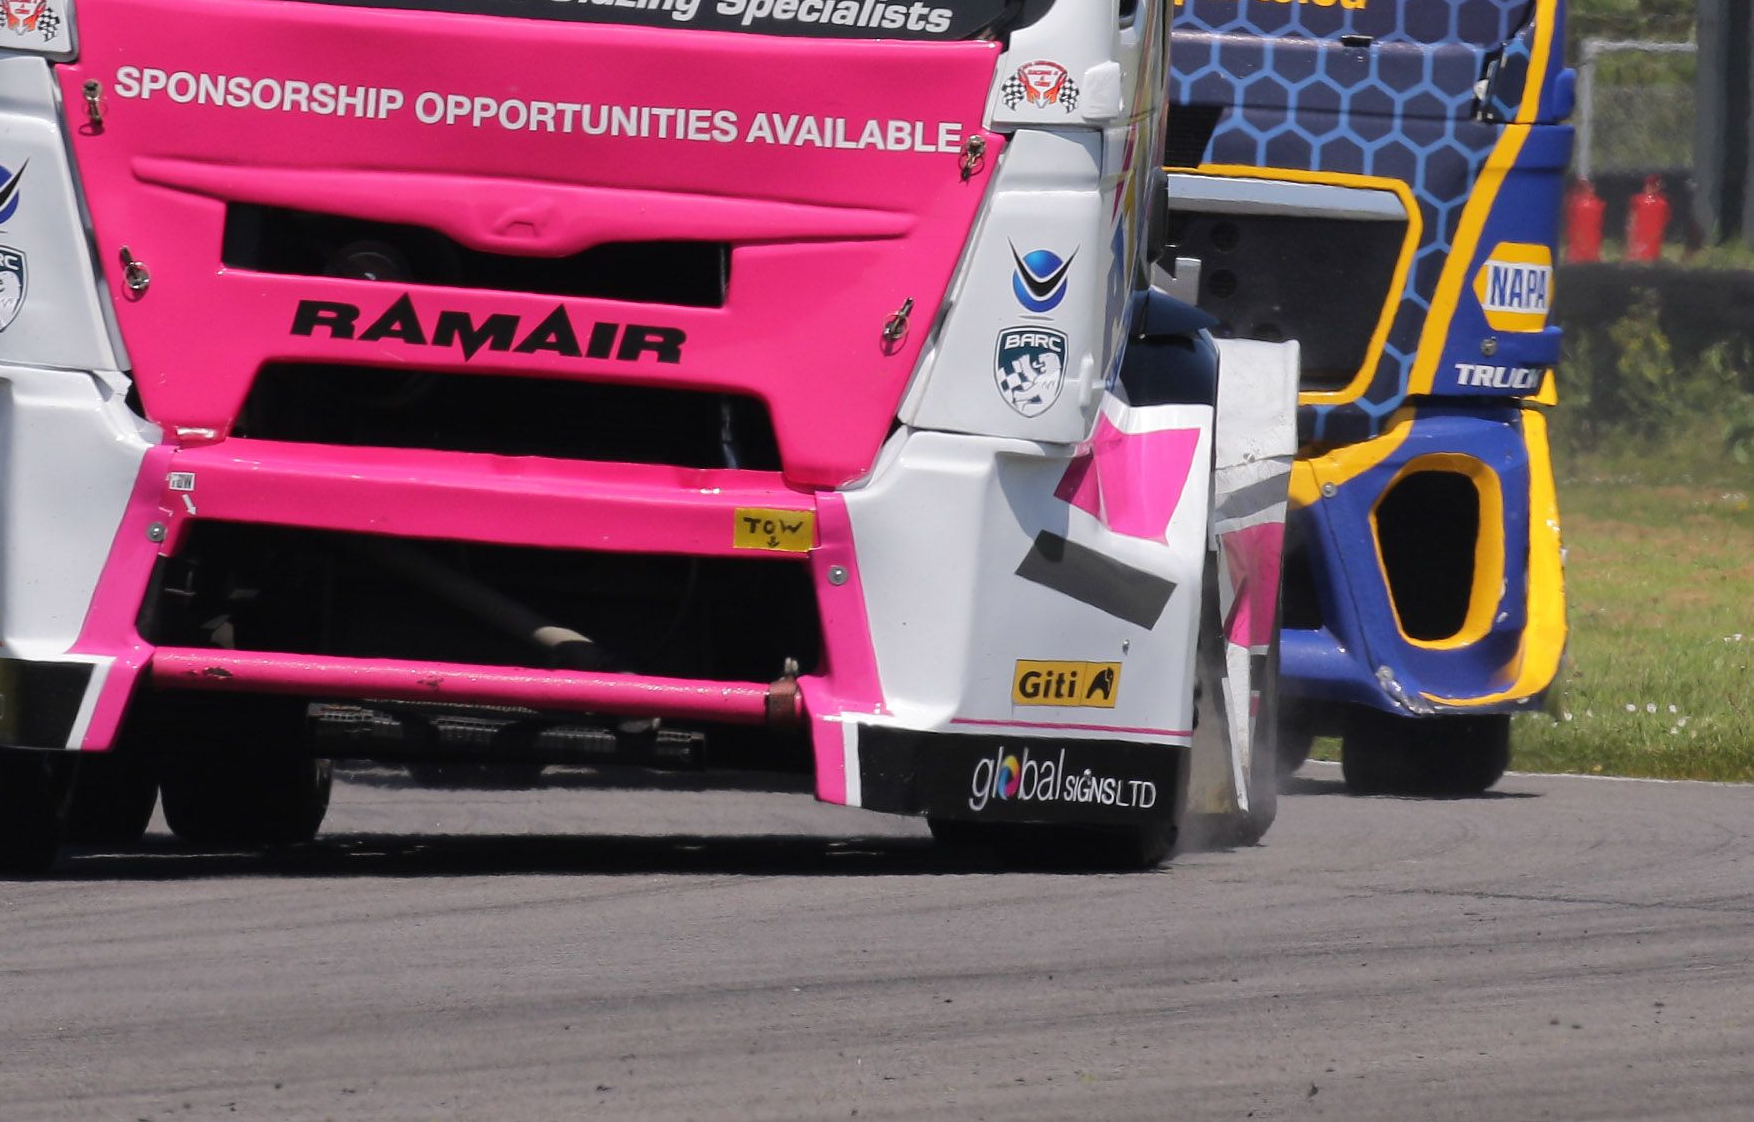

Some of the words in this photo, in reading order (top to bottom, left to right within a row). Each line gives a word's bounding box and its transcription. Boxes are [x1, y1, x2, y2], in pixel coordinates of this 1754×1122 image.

[115, 66, 405, 121] SPONSORSHIP
[414, 91, 739, 144] OPPORTUNITIES
[745, 112, 964, 155] AVAILABLE
[1490, 265, 1546, 310] NAPA
[289, 291, 688, 365] RAMAIR
[1003, 331, 1063, 353] BARC
[743, 514, 804, 535] TOW
[1018, 670, 1078, 699] Giti
[968, 745, 1066, 812] global
